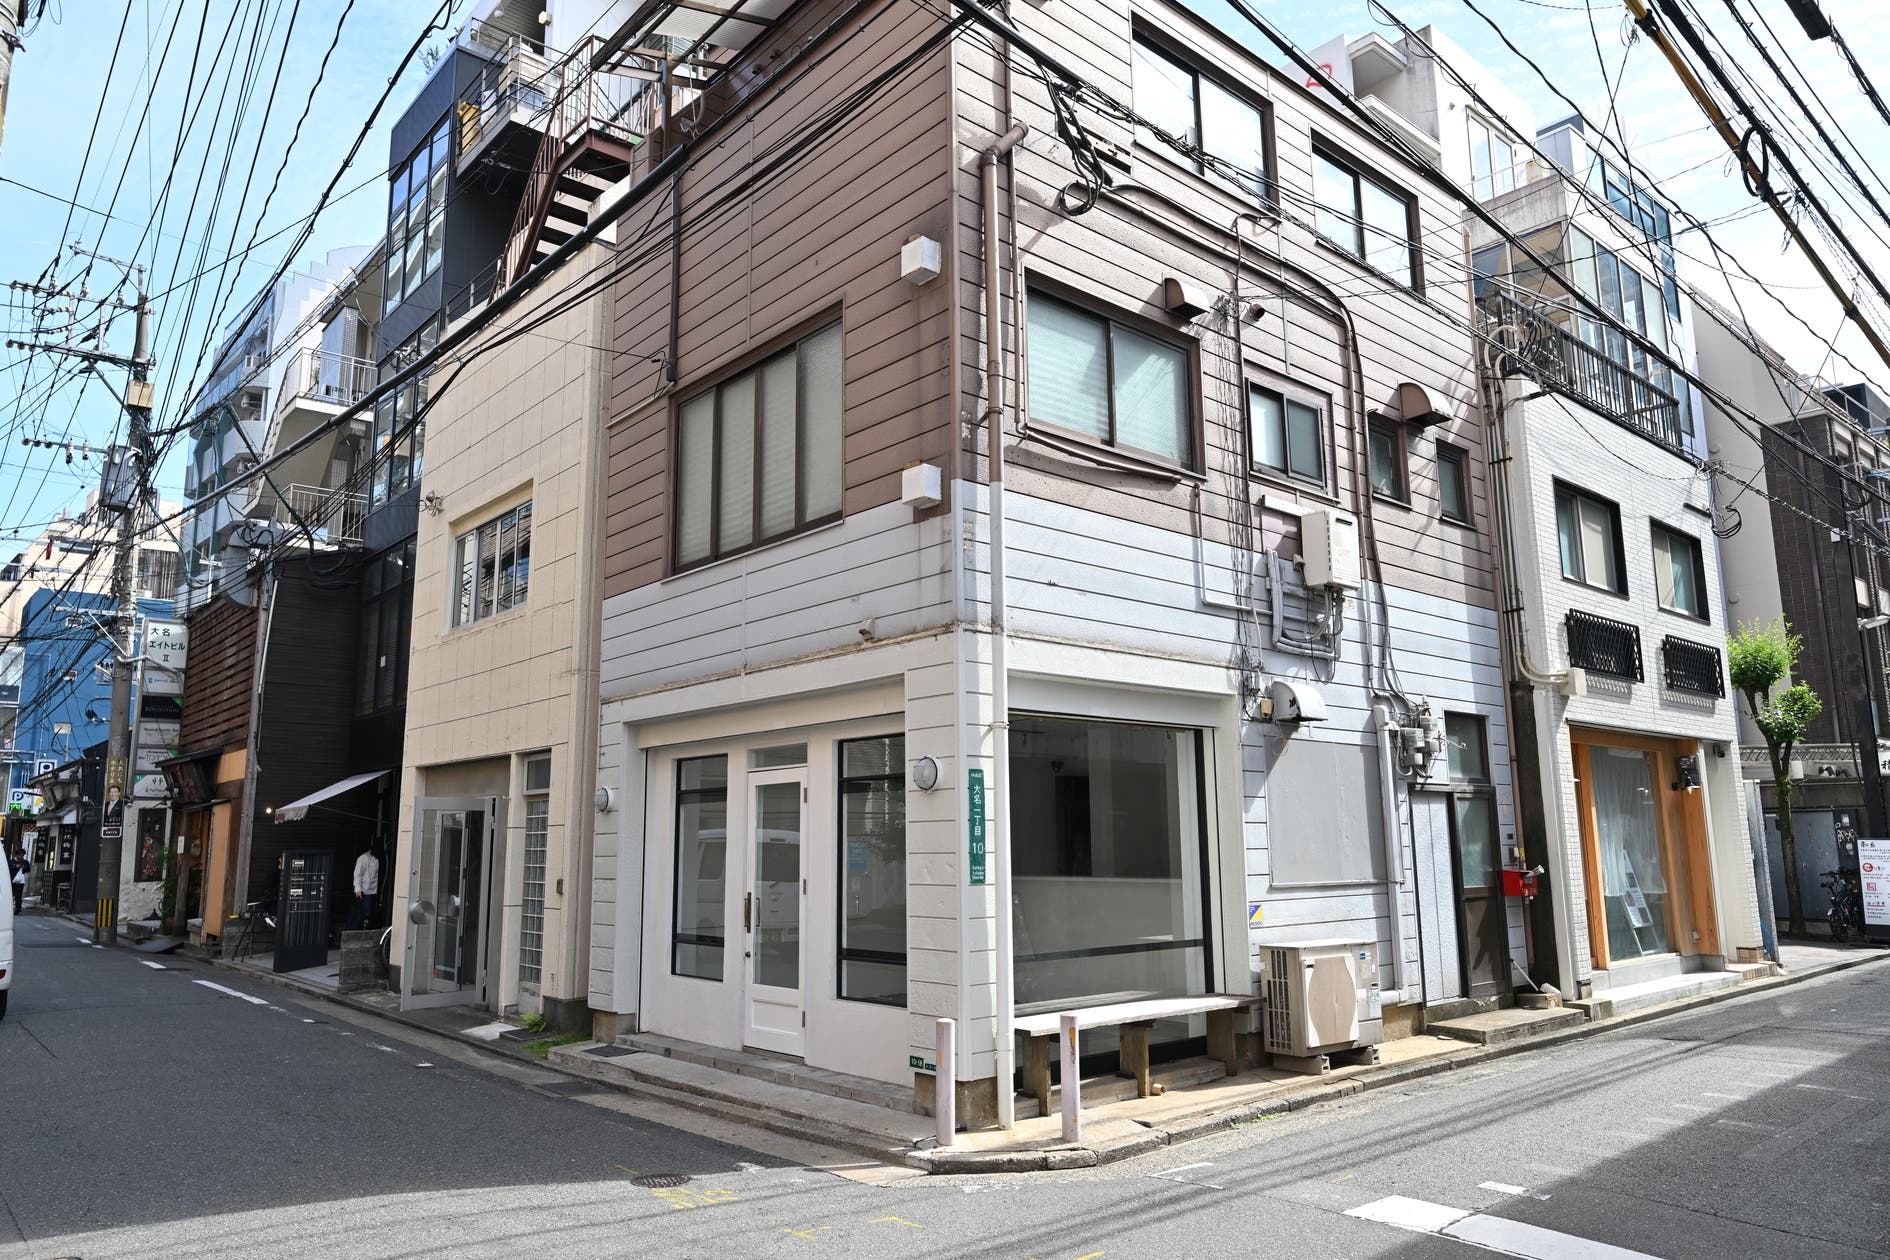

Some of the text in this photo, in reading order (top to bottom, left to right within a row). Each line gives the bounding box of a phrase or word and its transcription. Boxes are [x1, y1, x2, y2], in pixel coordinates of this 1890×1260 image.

[149, 641, 185, 650] エイトビル
[973, 784, 981, 836] 大名一丁目
[972, 842, 984, 854] 10
